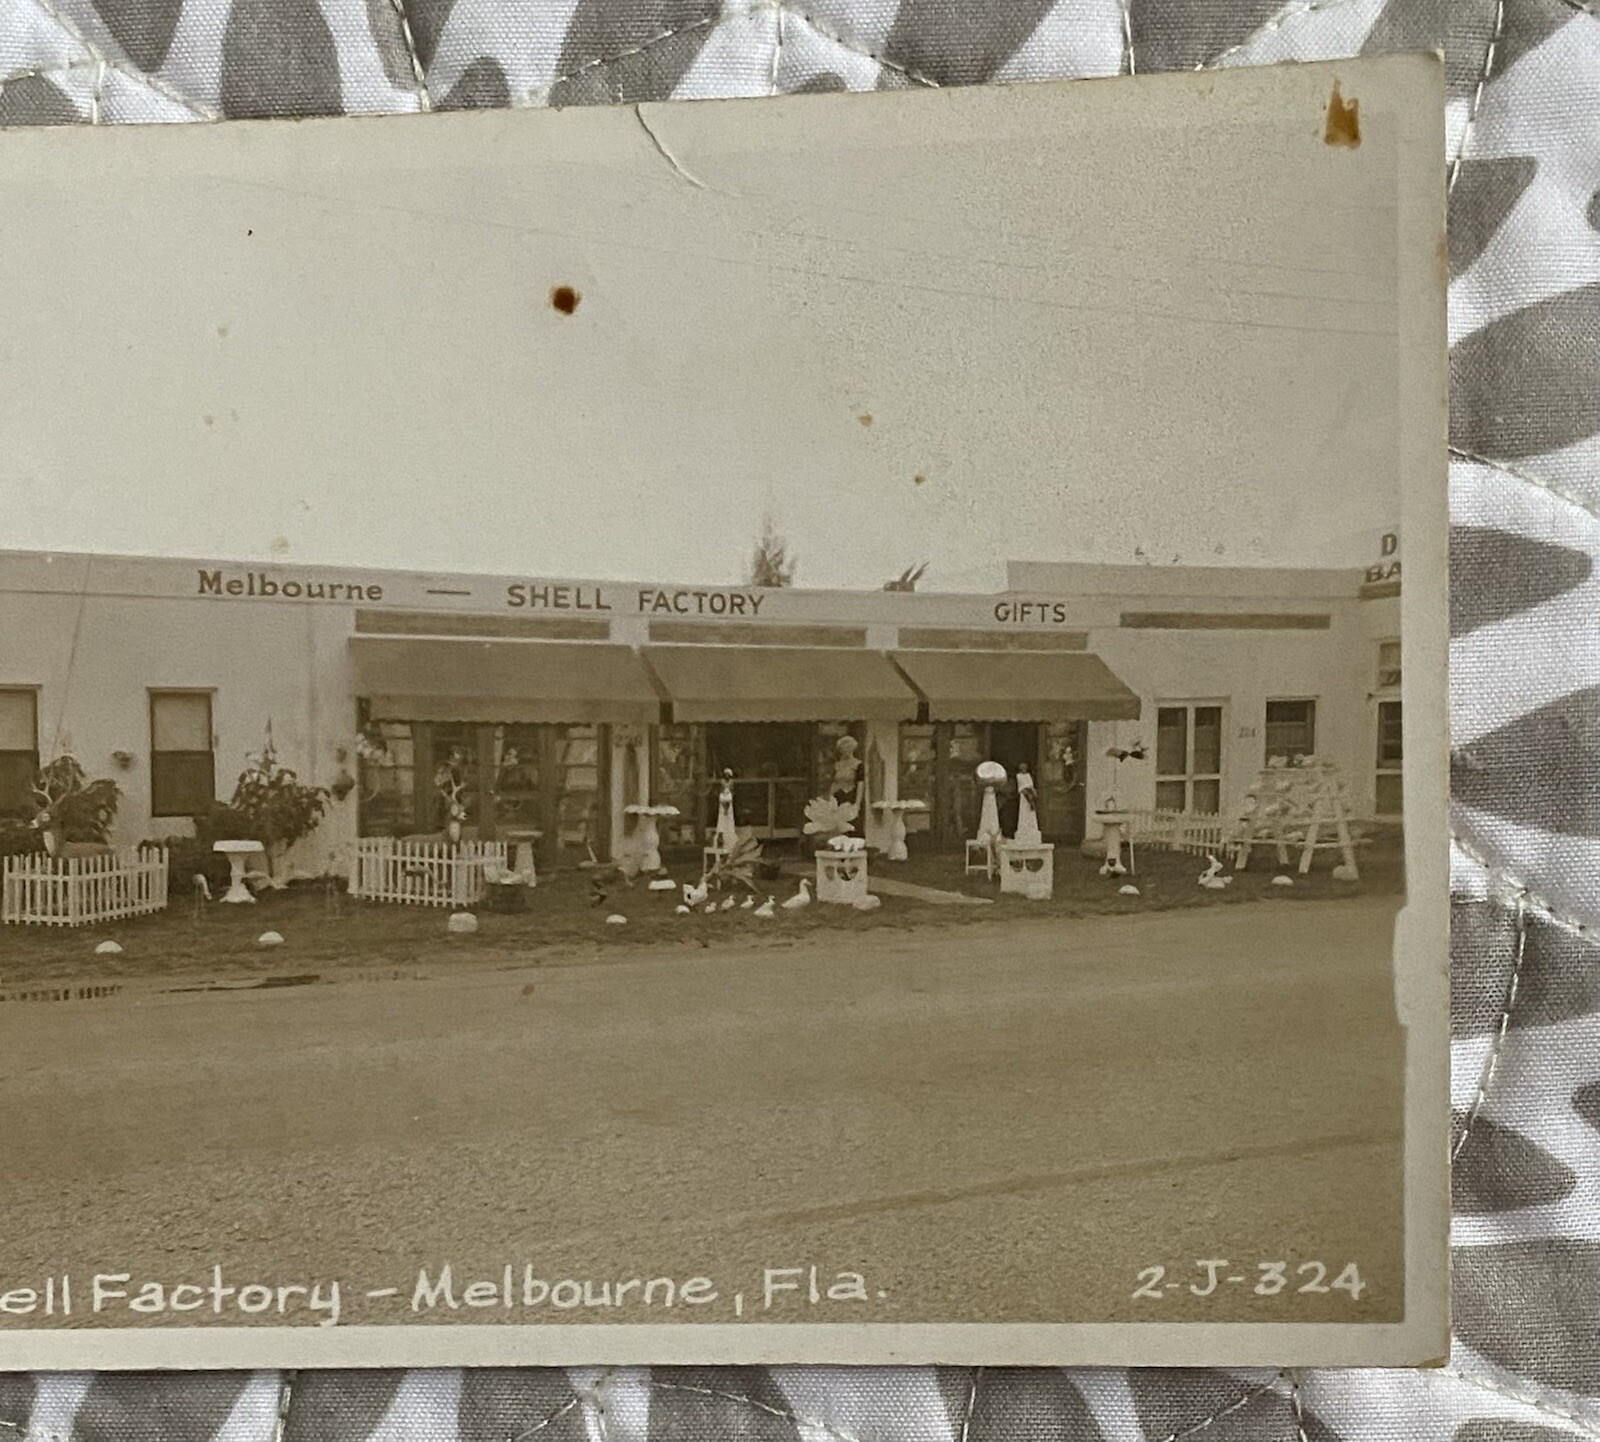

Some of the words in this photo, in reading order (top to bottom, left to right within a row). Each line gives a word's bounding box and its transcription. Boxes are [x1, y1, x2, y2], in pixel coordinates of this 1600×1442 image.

[198, 570, 383, 601] Melbourne
[507, 584, 612, 611] SHELL
[638, 590, 765, 616] FACTORY
[994, 602, 1066, 623] GIFTS
[92, 1264, 341, 1327] Factory
[763, 1266, 888, 1309] Fla.
[1131, 1259, 1366, 1300] 2-J-324
